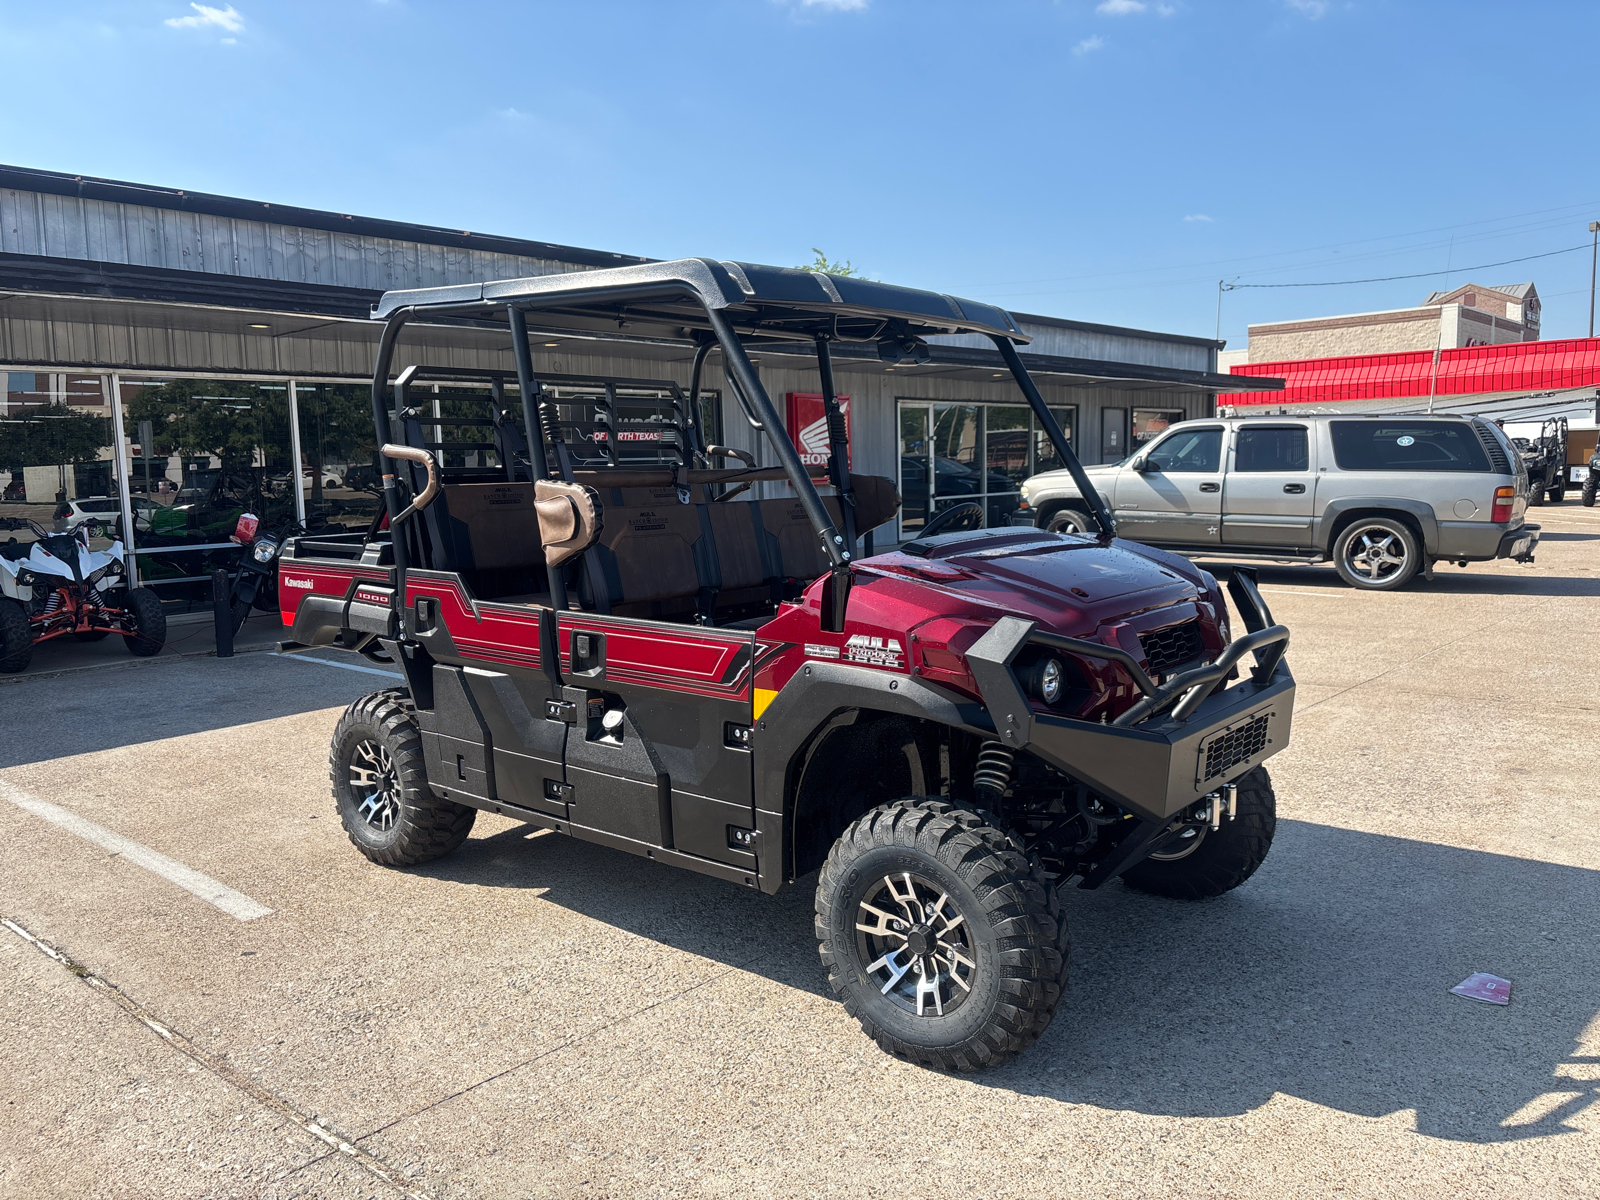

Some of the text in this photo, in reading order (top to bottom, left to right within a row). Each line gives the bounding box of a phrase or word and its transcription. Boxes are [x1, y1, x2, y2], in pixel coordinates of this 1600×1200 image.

[800, 453, 840, 466] HON
[284, 576, 314, 590] Kawasaki
[358, 592, 388, 602] 1000
